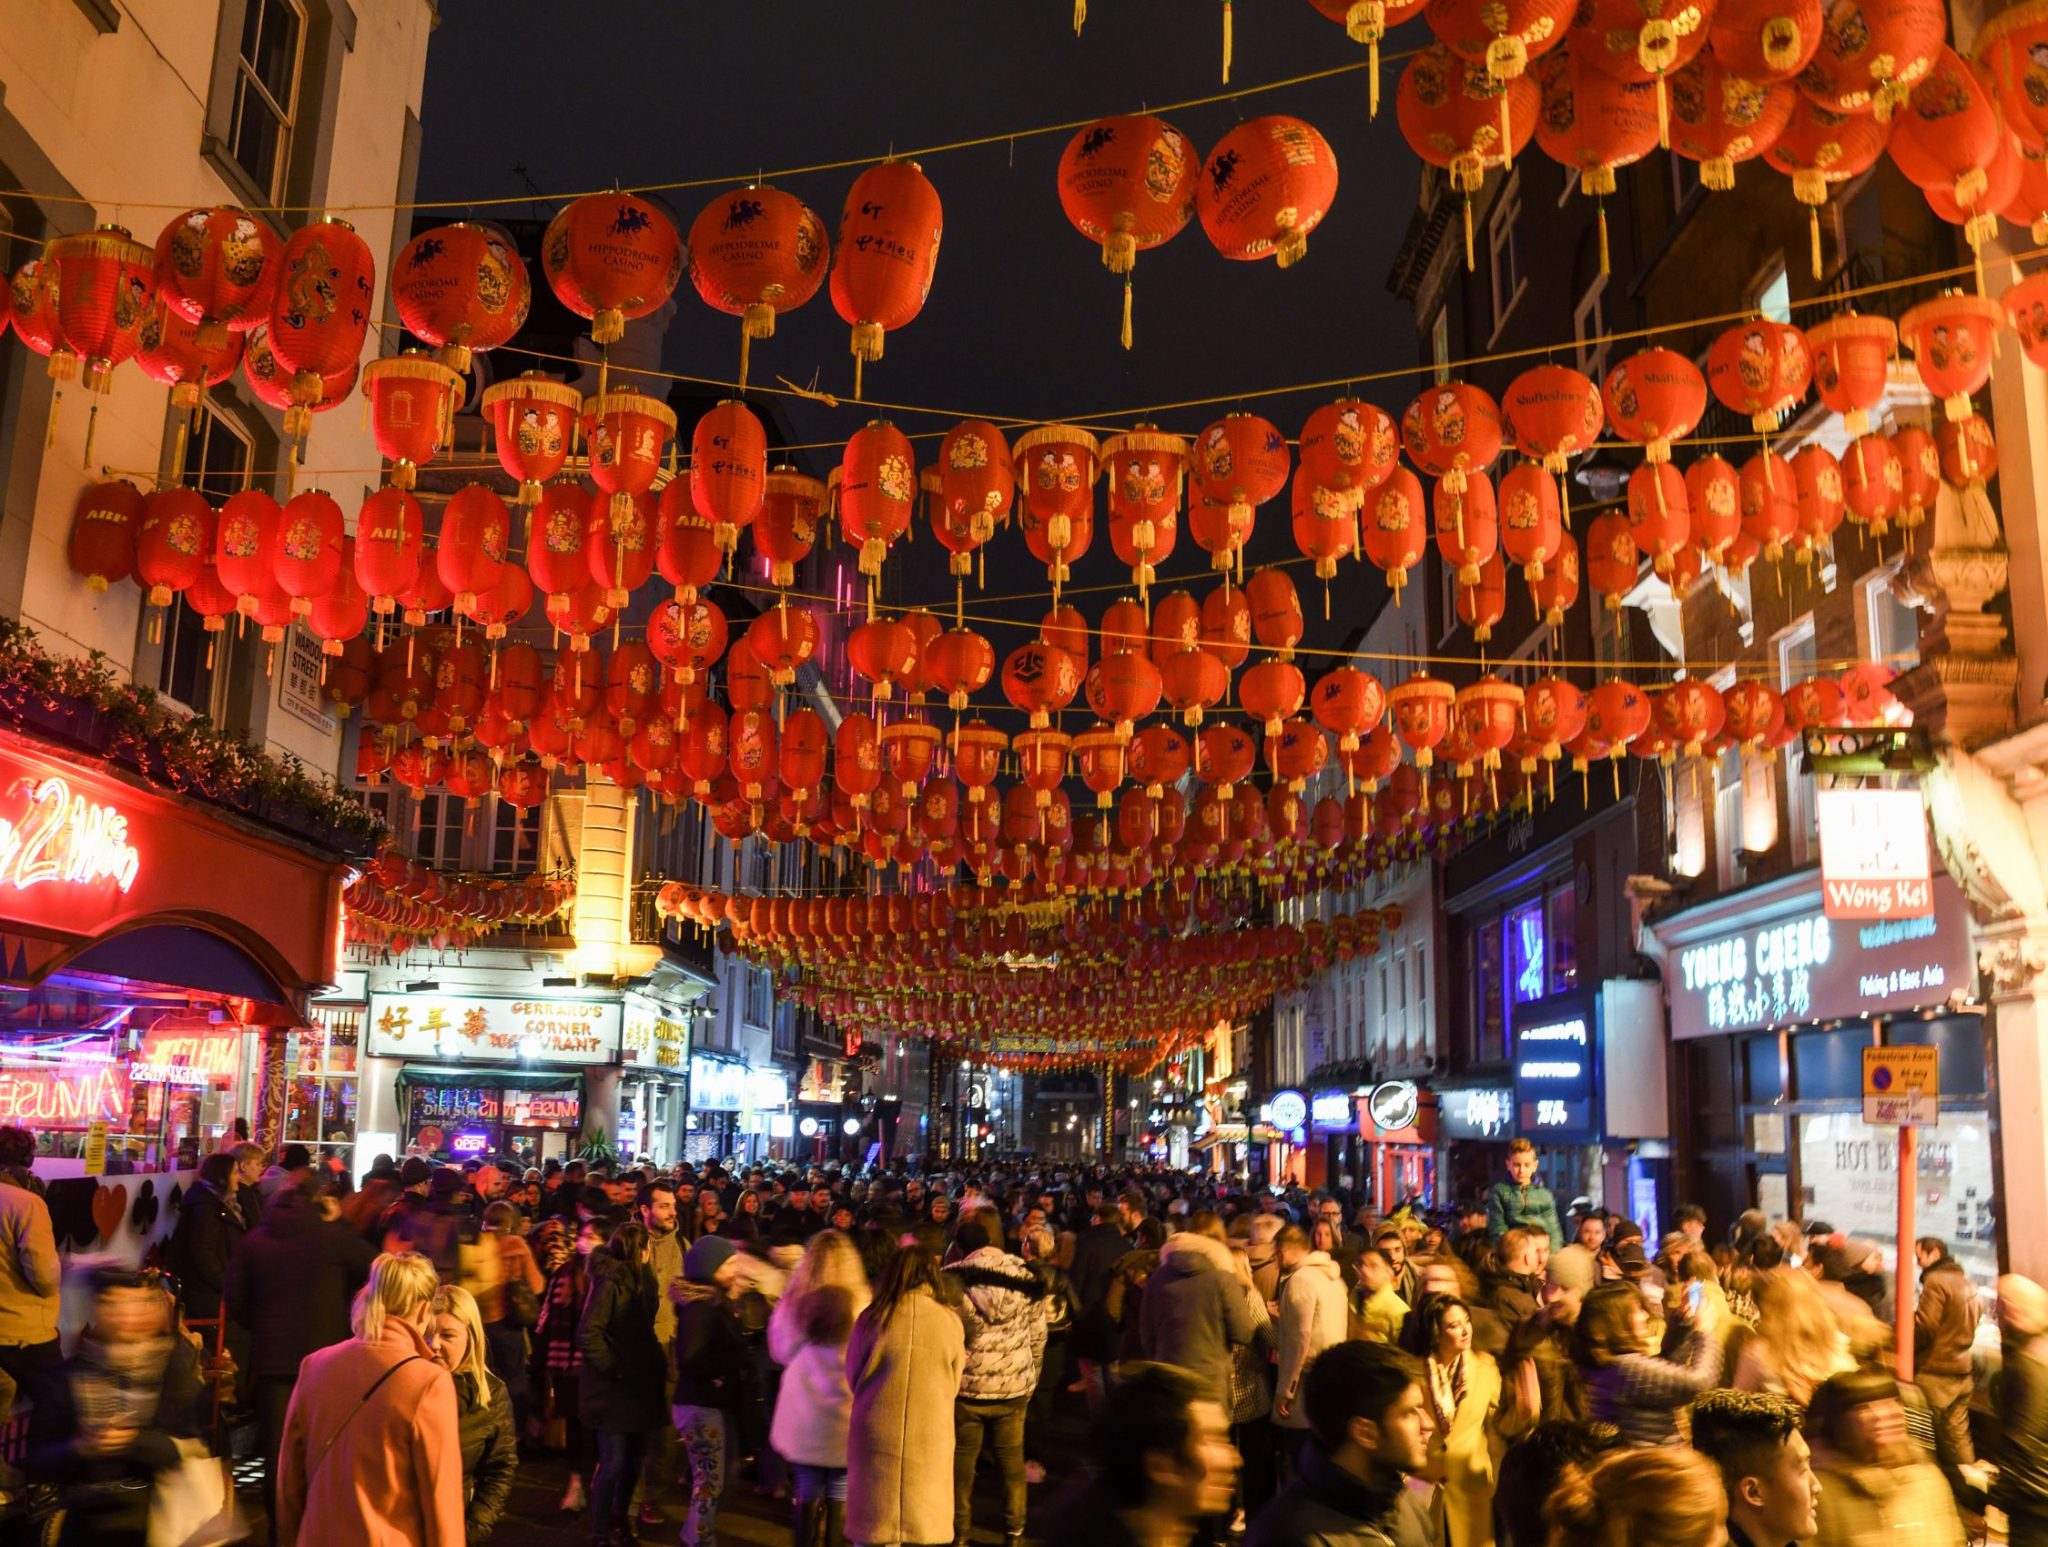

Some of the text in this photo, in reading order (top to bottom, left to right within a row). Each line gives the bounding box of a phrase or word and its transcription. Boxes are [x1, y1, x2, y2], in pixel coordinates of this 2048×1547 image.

[588, 242, 660, 265] HIPPODROME
[709, 240, 781, 256] HIPPODROME
[722, 250, 765, 262] CASINO
[603, 256, 645, 271] CASINO
[1515, 388, 1583, 404] Shaftesbury
[294, 631, 324, 664] WARDOU
[291, 650, 319, 681] STREET
[1828, 881, 1928, 913] Wong Kei
[1682, 916, 1831, 990] YOUNG CHENG
[511, 1001, 603, 1019] GERRARD'S
[524, 1019, 593, 1036] CORNER
[454, 1136, 487, 1151] OPEN
[1835, 1141, 1871, 1170] HOT
